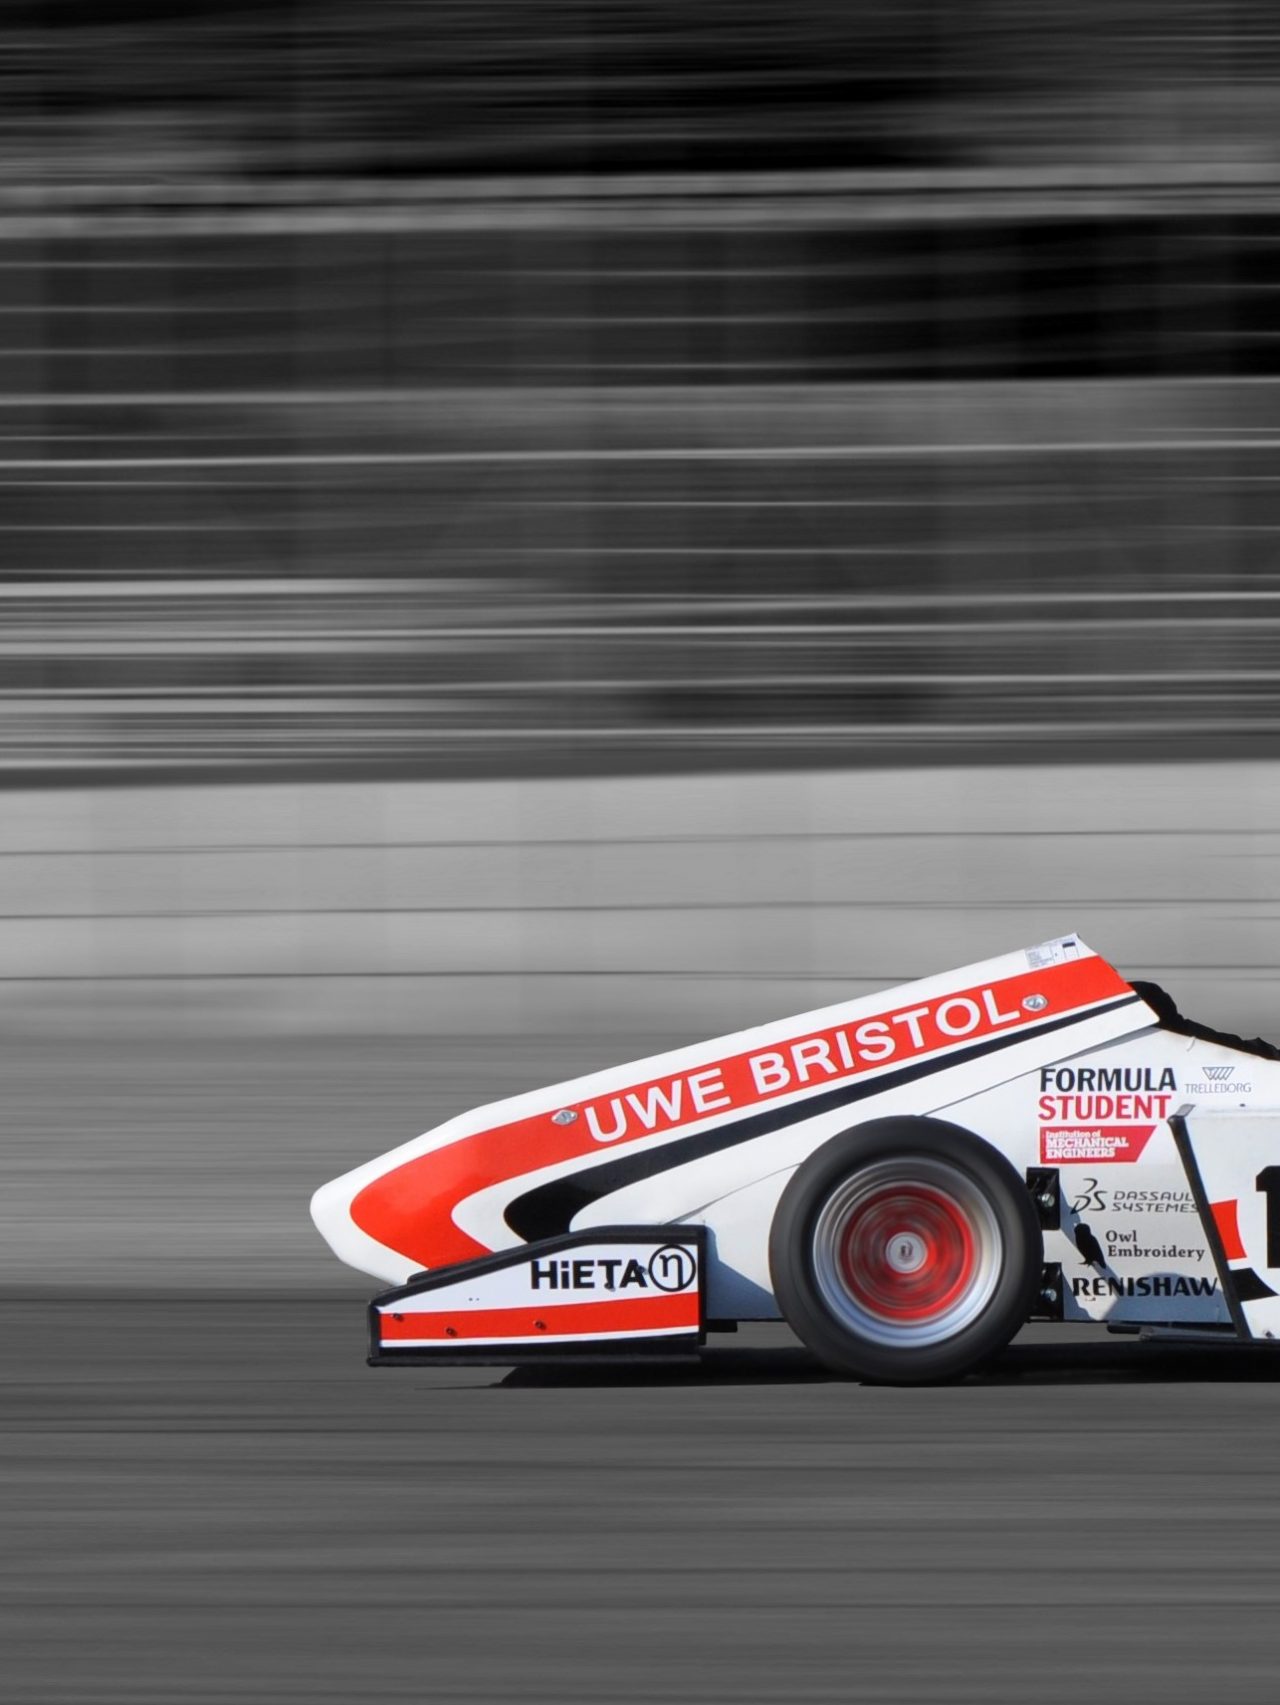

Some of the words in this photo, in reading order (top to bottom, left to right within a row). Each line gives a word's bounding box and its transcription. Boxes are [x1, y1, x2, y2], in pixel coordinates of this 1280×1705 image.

[584, 1067, 732, 1143] UWE
[748, 989, 1020, 1095] BRISTOL
[1040, 1067, 1177, 1092] FORMULA
[1184, 1083, 1252, 1094] TRELLEBORG
[1038, 1095, 1172, 1121] STUDENT
[1046, 1137, 1129, 1148] MECHANICAL
[1046, 1148, 1116, 1159] ENGINEERS
[1113, 1191, 1195, 1201] DASSAUL
[1105, 1230, 1137, 1243] Owl
[1108, 1245, 1205, 1261] Embroidery
[1072, 1277, 1218, 1296] RENISHAW
